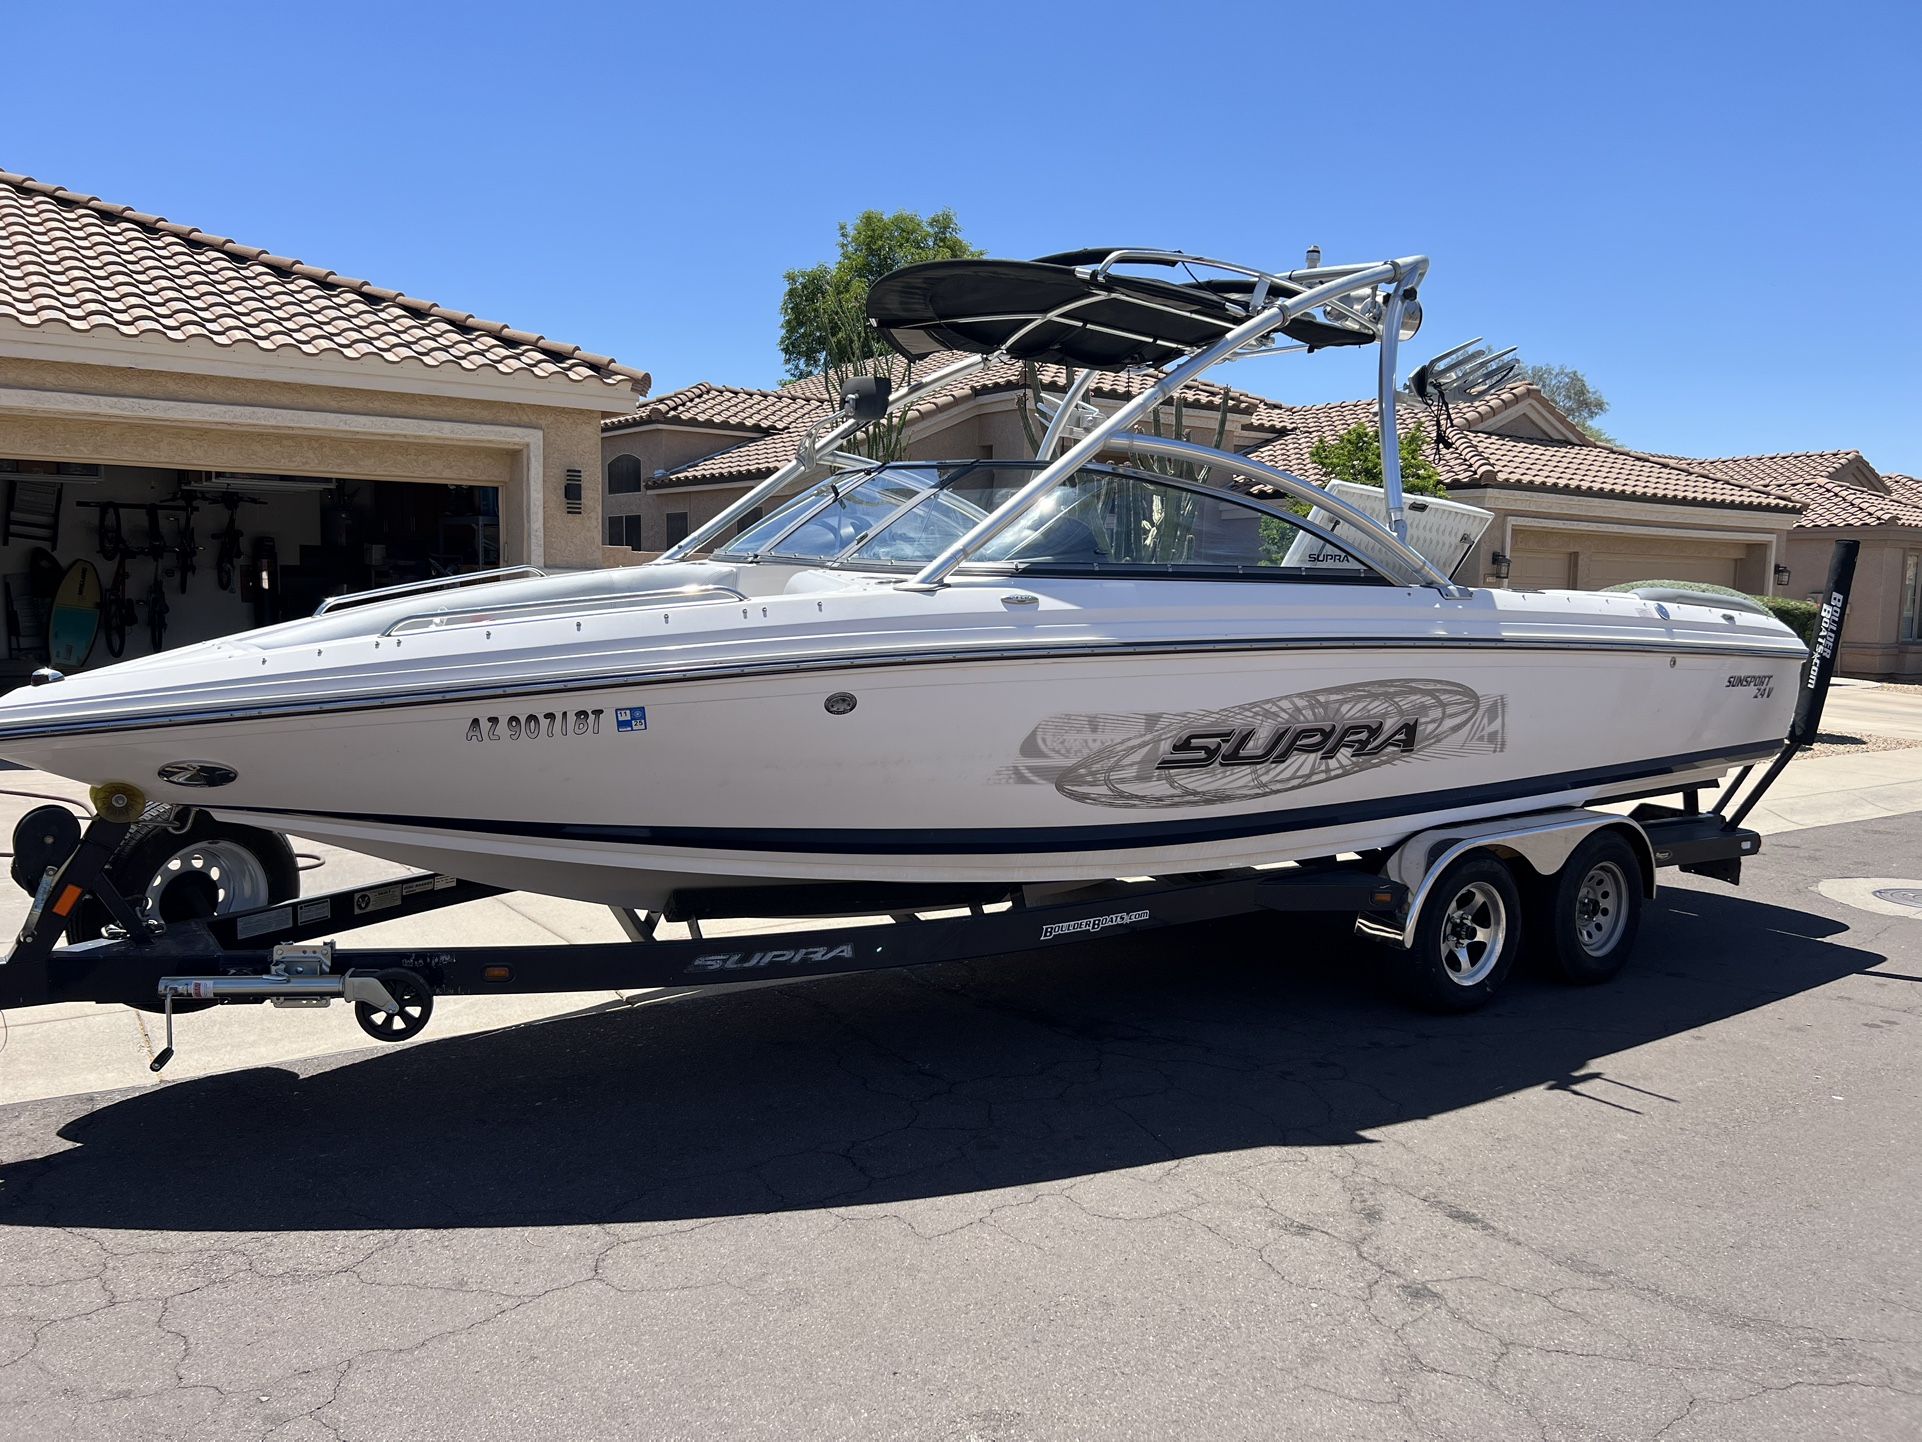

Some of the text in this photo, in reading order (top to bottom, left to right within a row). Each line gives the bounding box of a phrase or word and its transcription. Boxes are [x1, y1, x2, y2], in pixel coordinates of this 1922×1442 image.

[1308, 553, 1350, 563] SUPRA
[1725, 675, 1774, 687] SUNSPORT
[466, 717, 501, 742] AZ
[1154, 715, 1419, 770] SUPRA
[684, 942, 855, 974] SUPRA
